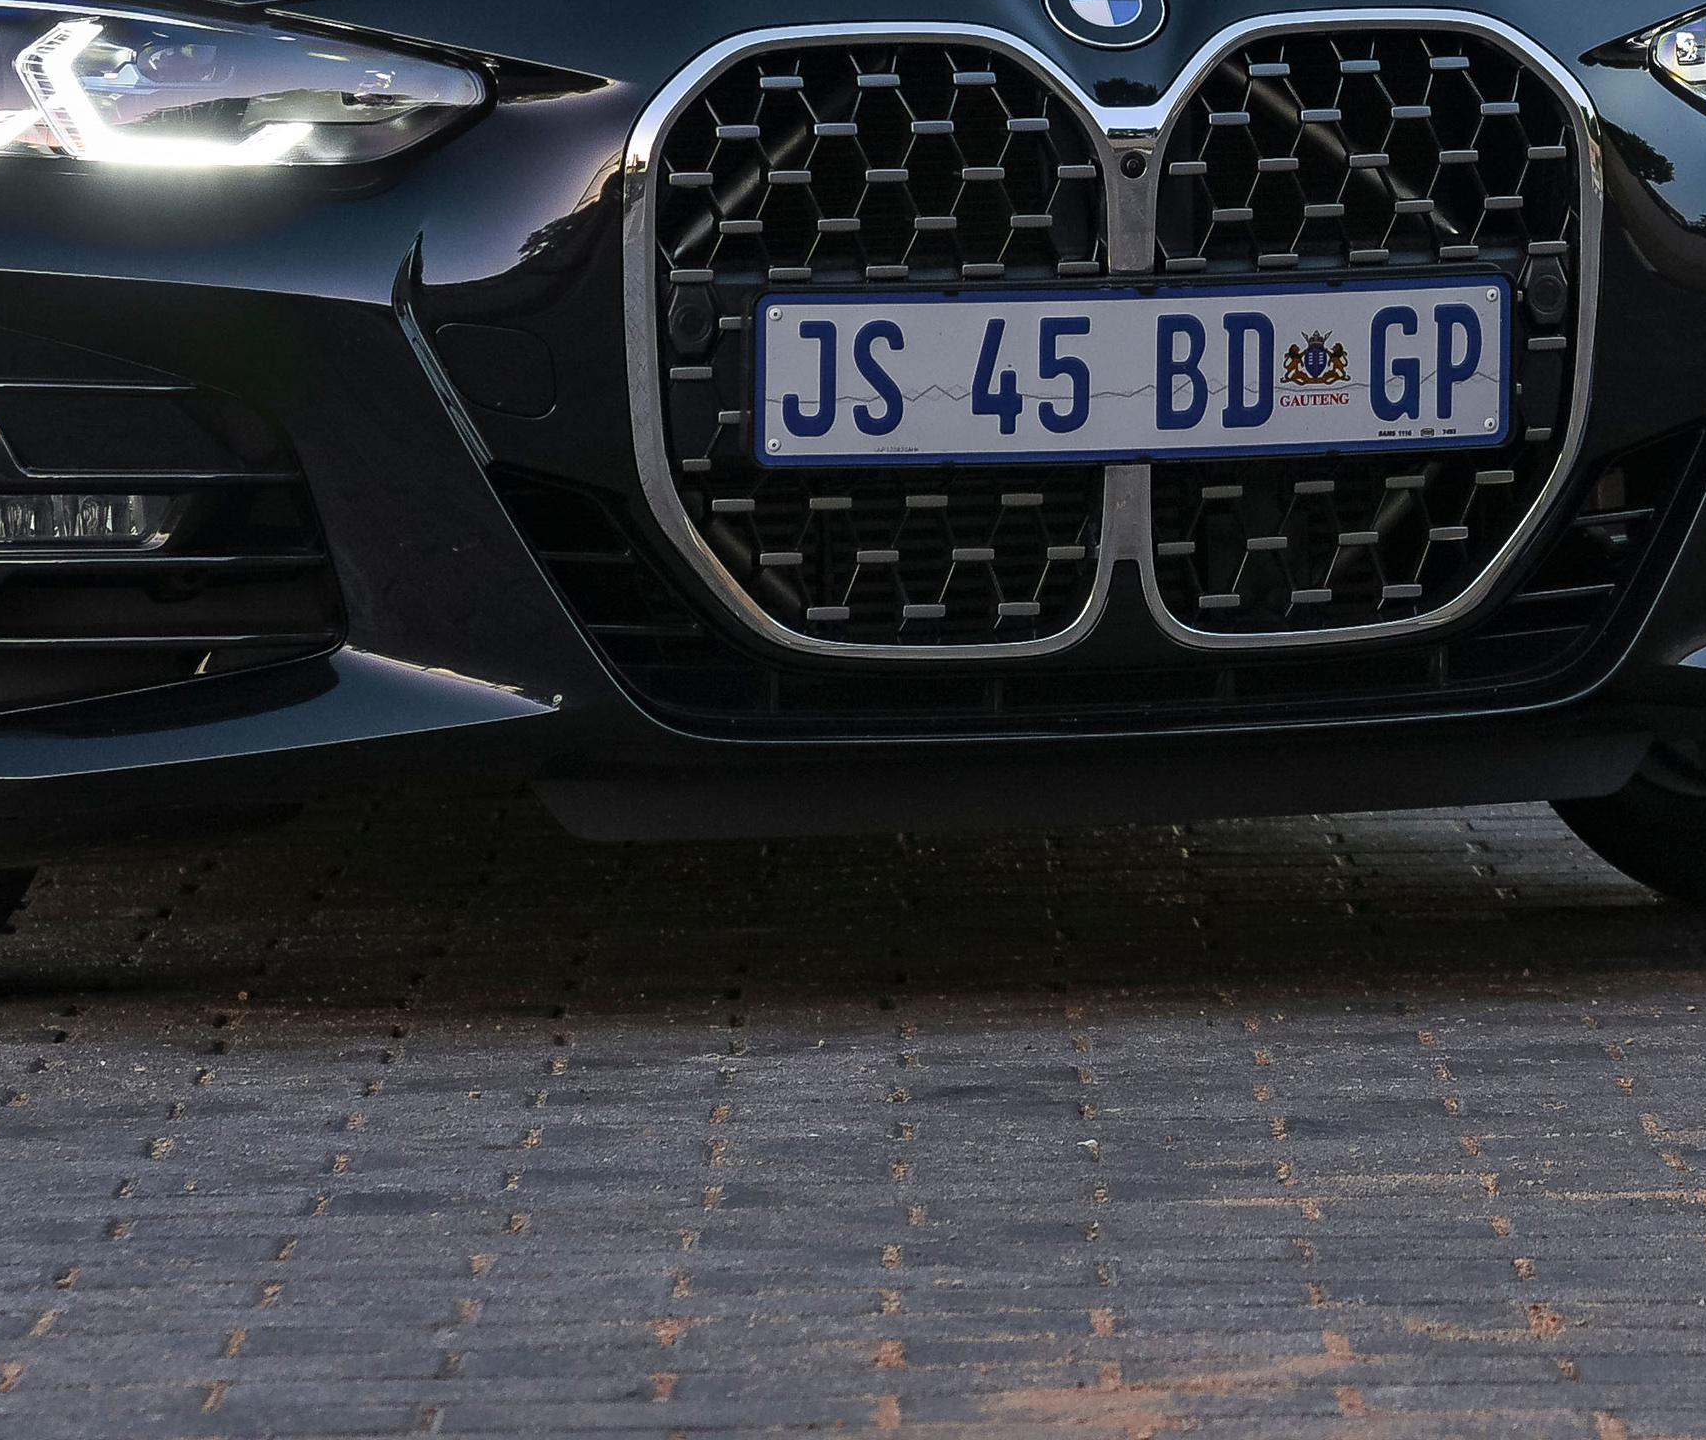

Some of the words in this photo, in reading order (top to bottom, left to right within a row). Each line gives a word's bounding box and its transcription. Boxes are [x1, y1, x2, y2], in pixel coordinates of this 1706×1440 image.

[782, 319, 904, 438] JS
[971, 317, 1090, 435] 45
[1155, 312, 1275, 431] BD
[1369, 303, 1483, 422] GP
[1280, 393, 1350, 407] GAUTENG
